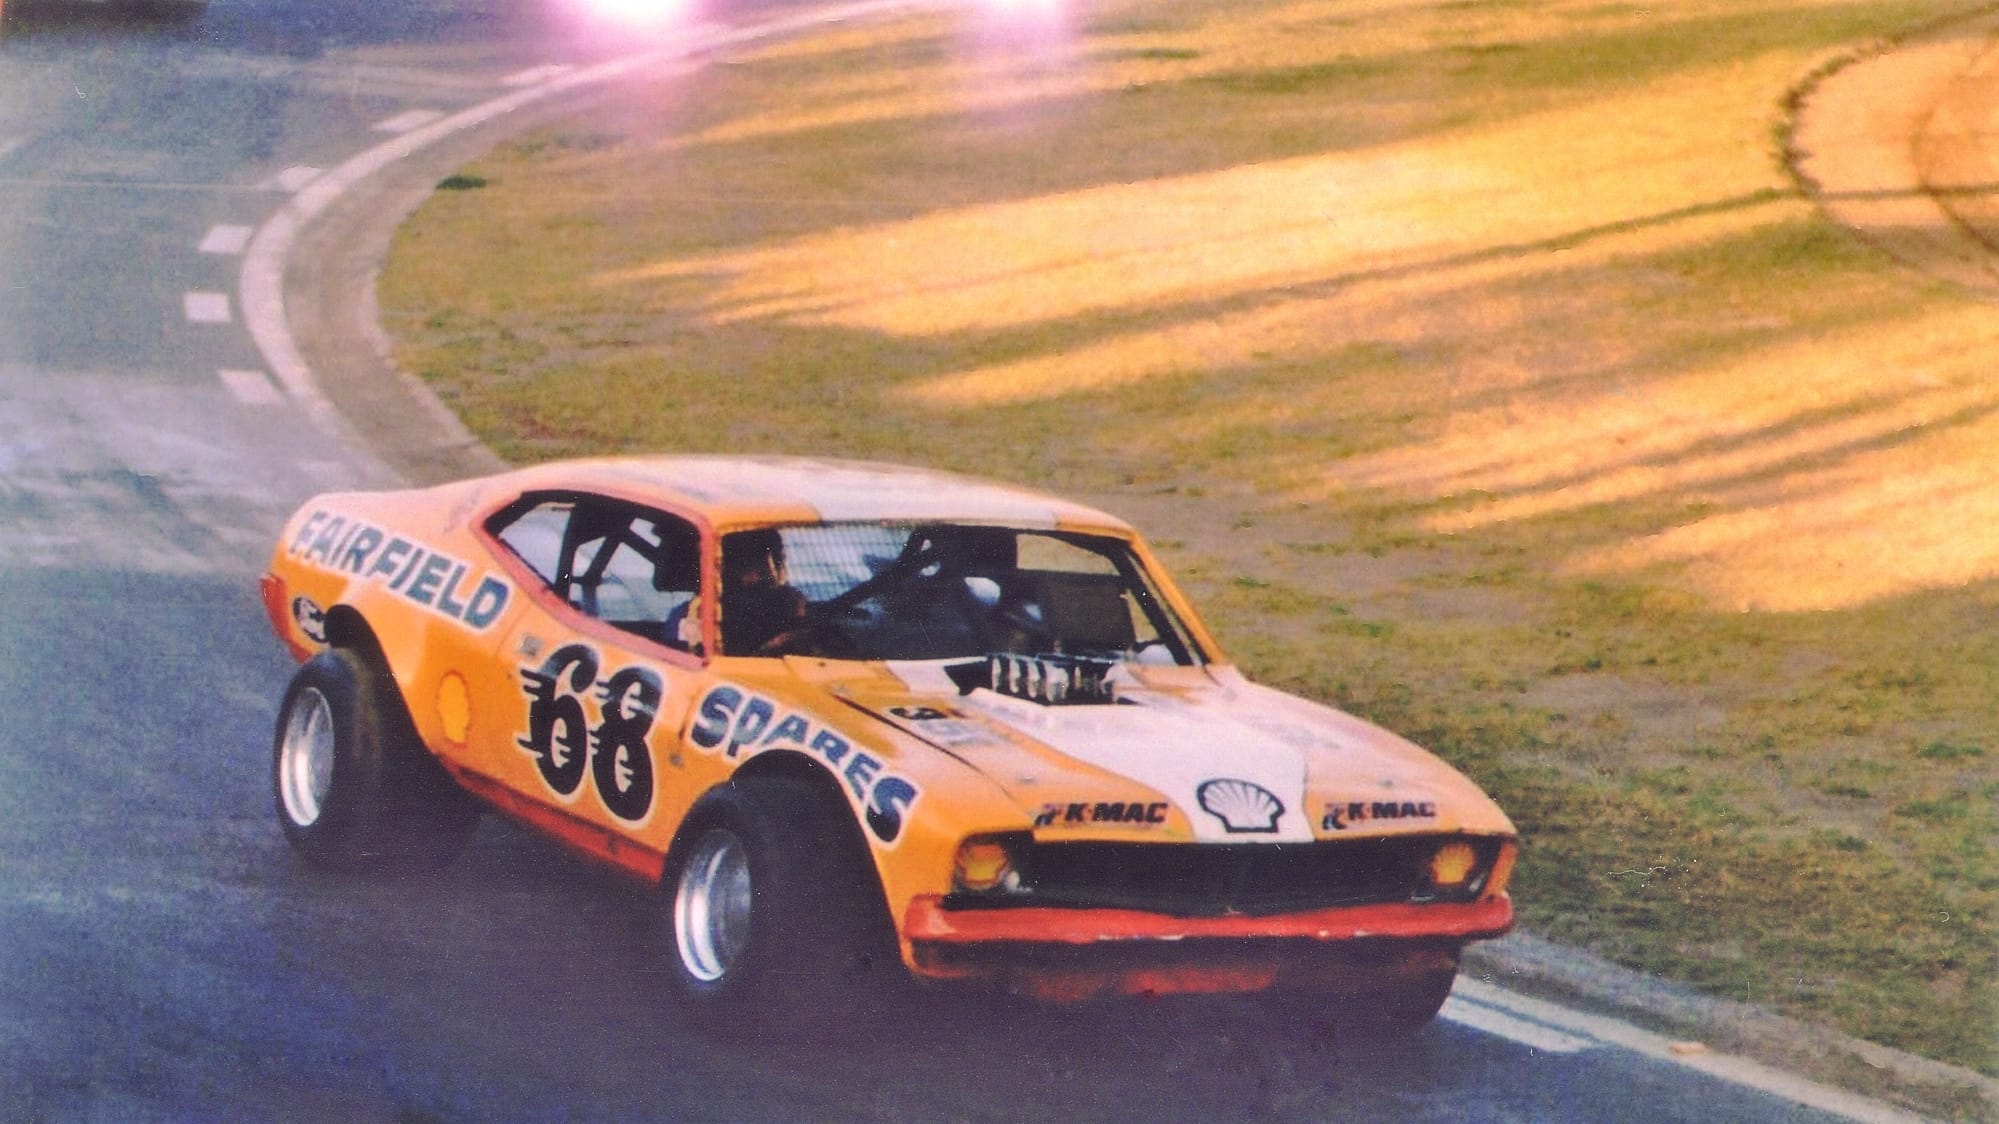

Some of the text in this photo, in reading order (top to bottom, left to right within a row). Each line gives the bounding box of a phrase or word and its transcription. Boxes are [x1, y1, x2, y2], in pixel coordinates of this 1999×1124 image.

[290, 511, 509, 630] FAIRFIELD
[517, 643, 663, 821] 68
[691, 686, 918, 843] SPARES
